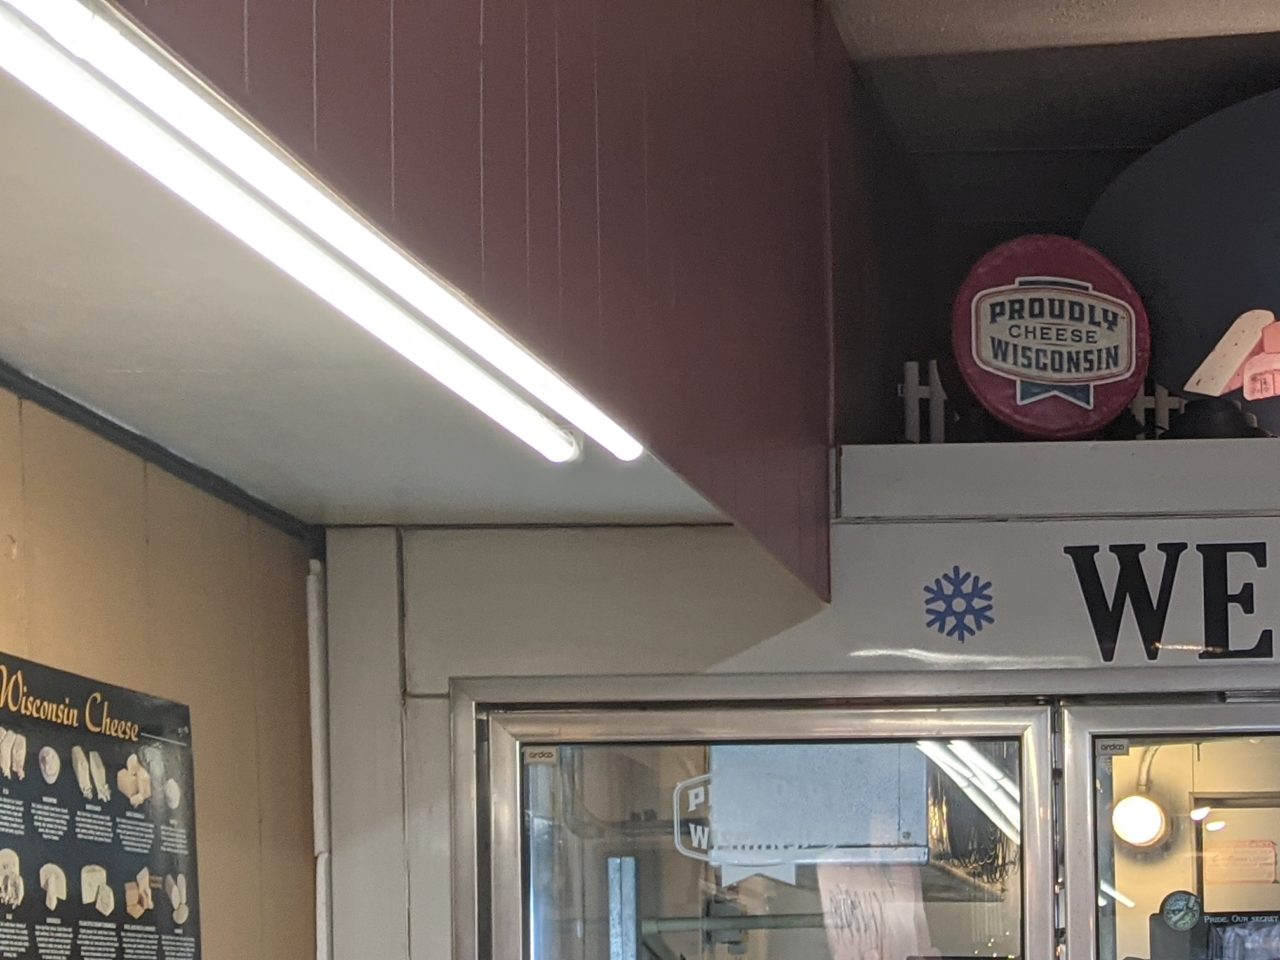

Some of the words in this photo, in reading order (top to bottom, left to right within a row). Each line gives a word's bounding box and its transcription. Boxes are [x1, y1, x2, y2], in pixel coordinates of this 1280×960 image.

[988, 298, 1123, 331] PROUDLY
[1008, 324, 1098, 344] CHEESE
[989, 336, 1120, 374] WISCONSIN
[0, 664, 79, 727] Wisconsin
[85, 691, 139, 741] Cheese
[1101, 743, 1126, 752] ardco
